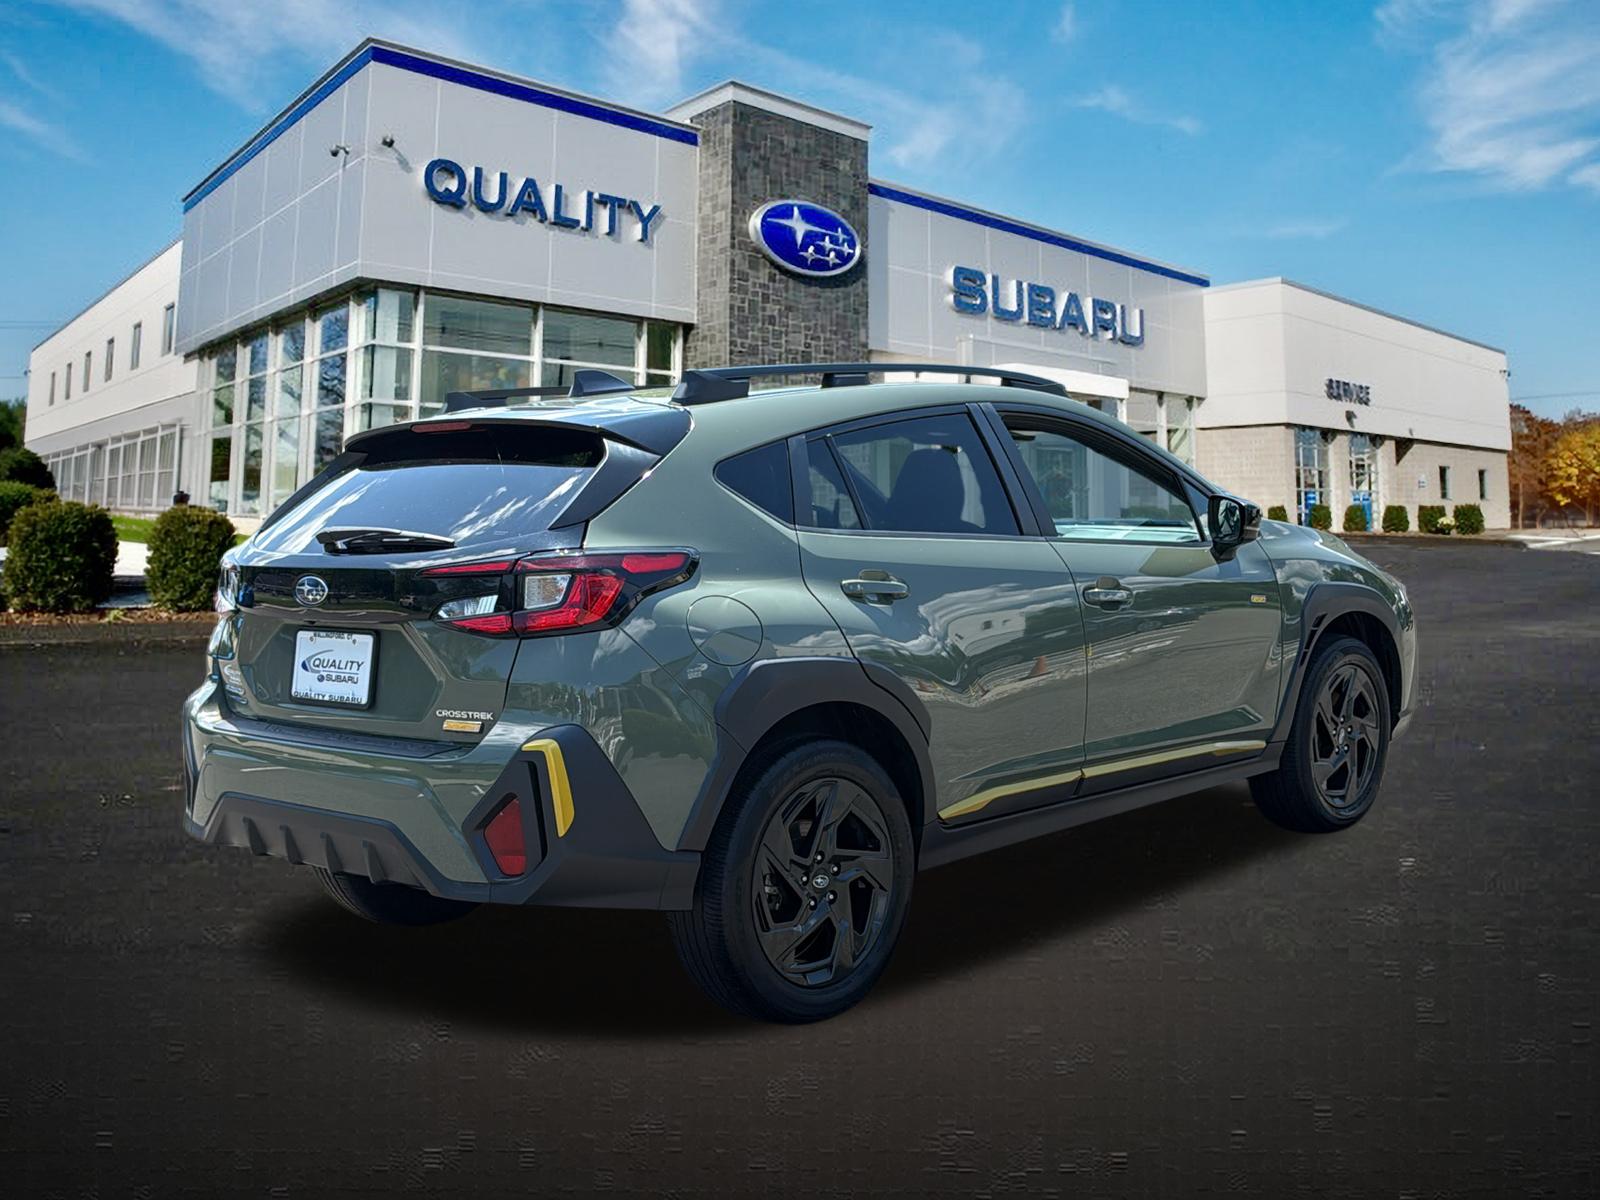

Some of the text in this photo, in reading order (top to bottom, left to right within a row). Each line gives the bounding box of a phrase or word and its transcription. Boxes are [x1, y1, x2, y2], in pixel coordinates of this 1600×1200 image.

[424, 158, 661, 242] QUALITY
[951, 265, 1144, 346] SUBARU
[1325, 378, 1370, 406] SERVICE
[312, 658, 364, 671] QUALITY
[325, 673, 359, 684] SUBARU
[294, 690, 363, 704] QUALITY SUBARU
[436, 709, 494, 720] CROSSTREK
